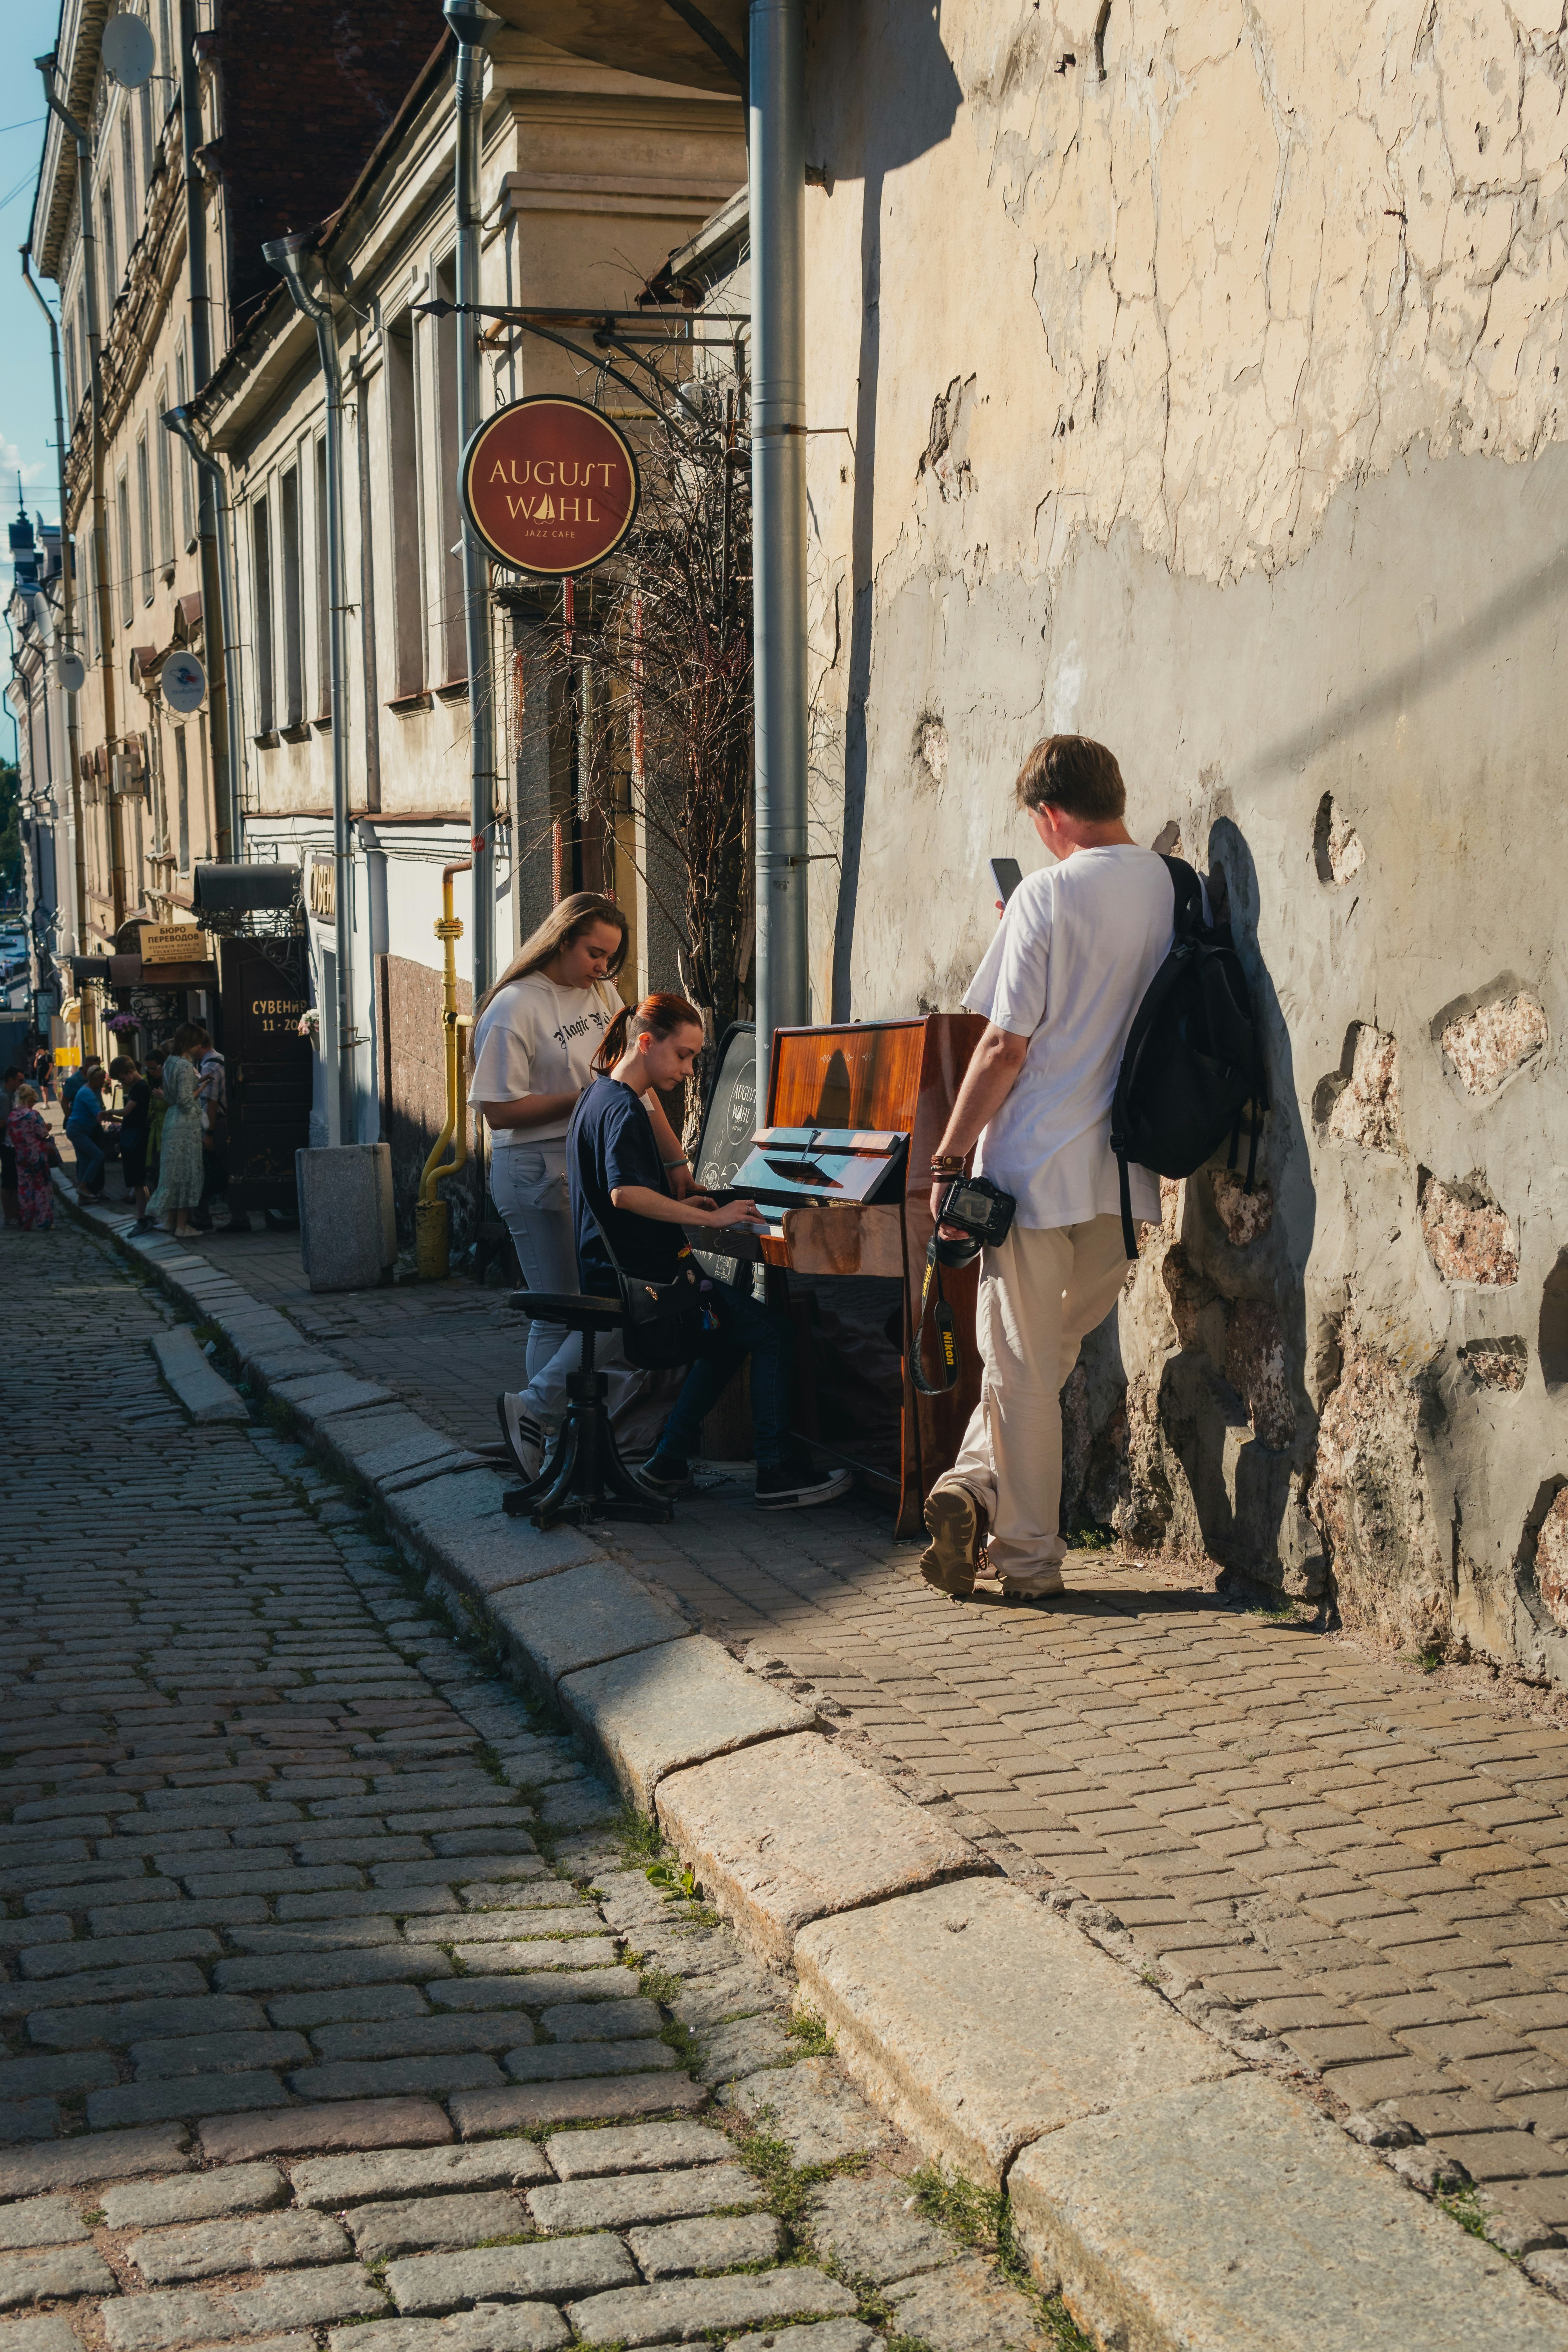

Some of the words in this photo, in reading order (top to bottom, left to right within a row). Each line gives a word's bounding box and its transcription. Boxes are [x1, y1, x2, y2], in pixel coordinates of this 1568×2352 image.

[488, 459, 616, 487] AUGUST
[148, 933, 199, 943] ПЕРЕВОДОВ
[263, 1020, 274, 1031] 11
[922, 1263, 932, 1297] Nikon
[943, 1332, 954, 1365] Nikon
